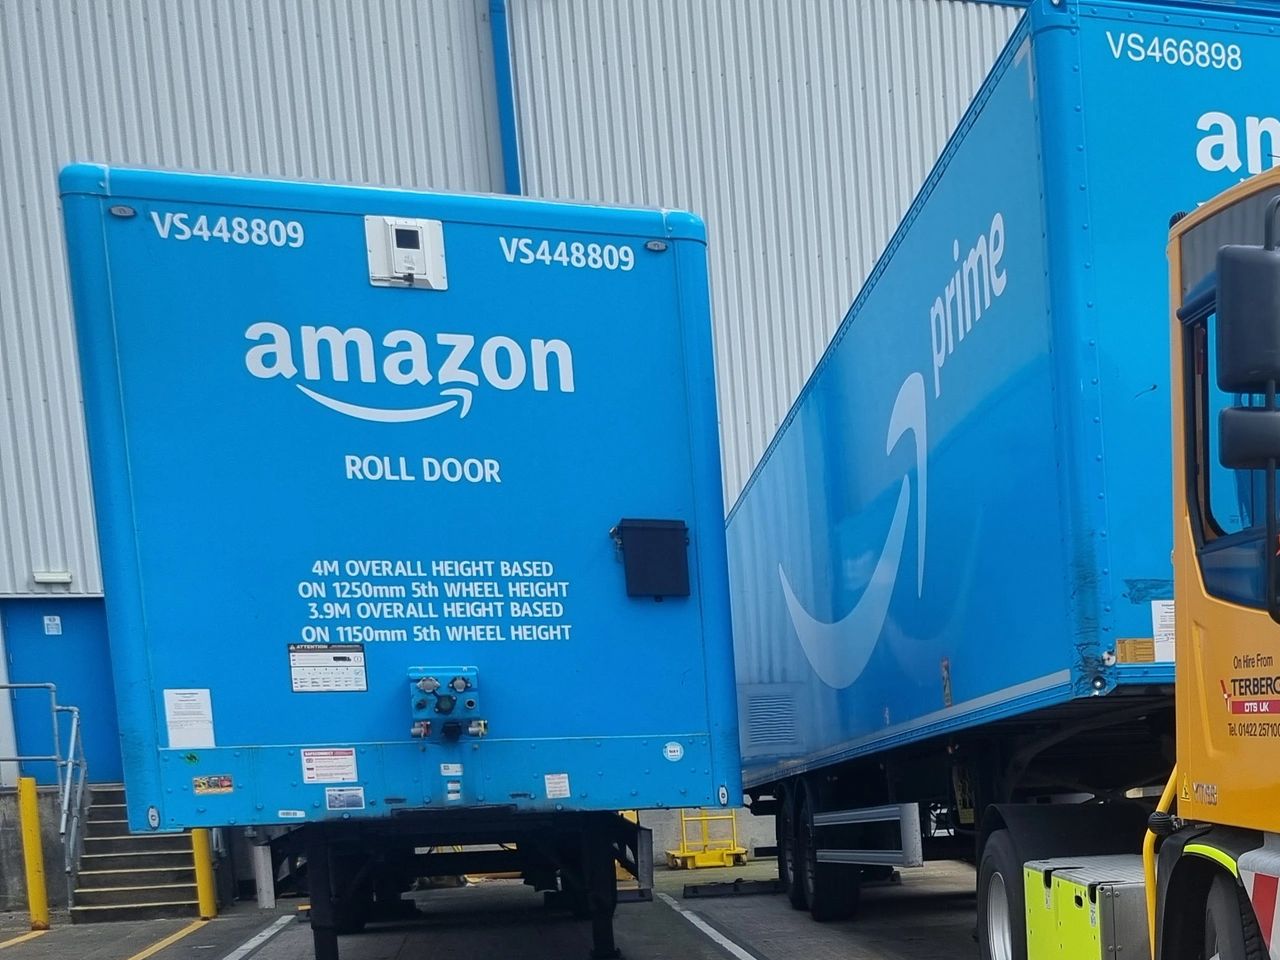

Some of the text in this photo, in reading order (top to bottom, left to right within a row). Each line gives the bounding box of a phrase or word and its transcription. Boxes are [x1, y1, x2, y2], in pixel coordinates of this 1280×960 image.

[1105, 31, 1242, 71] VS466898
[150, 211, 305, 248] VS448809
[498, 237, 635, 271] VS448809
[930, 212, 1007, 399] prime
[244, 321, 575, 393] amazon
[345, 455, 502, 483] ROLL DOOR
[312, 560, 554, 577] 4M OVERALL HEIGHT BASED
[298, 580, 570, 598] ON 1250mm 5th WHEEL HEIGHT
[308, 601, 564, 619] 3.9M OVERALL HEIGHT BASED
[301, 624, 572, 642] ON 1150mm 5th WHEEL HEIGHT
[1233, 653, 1273, 669] On Hire From
[1244, 701, 1270, 713] DTS UK
[1238, 722, 1257, 737] 01422
